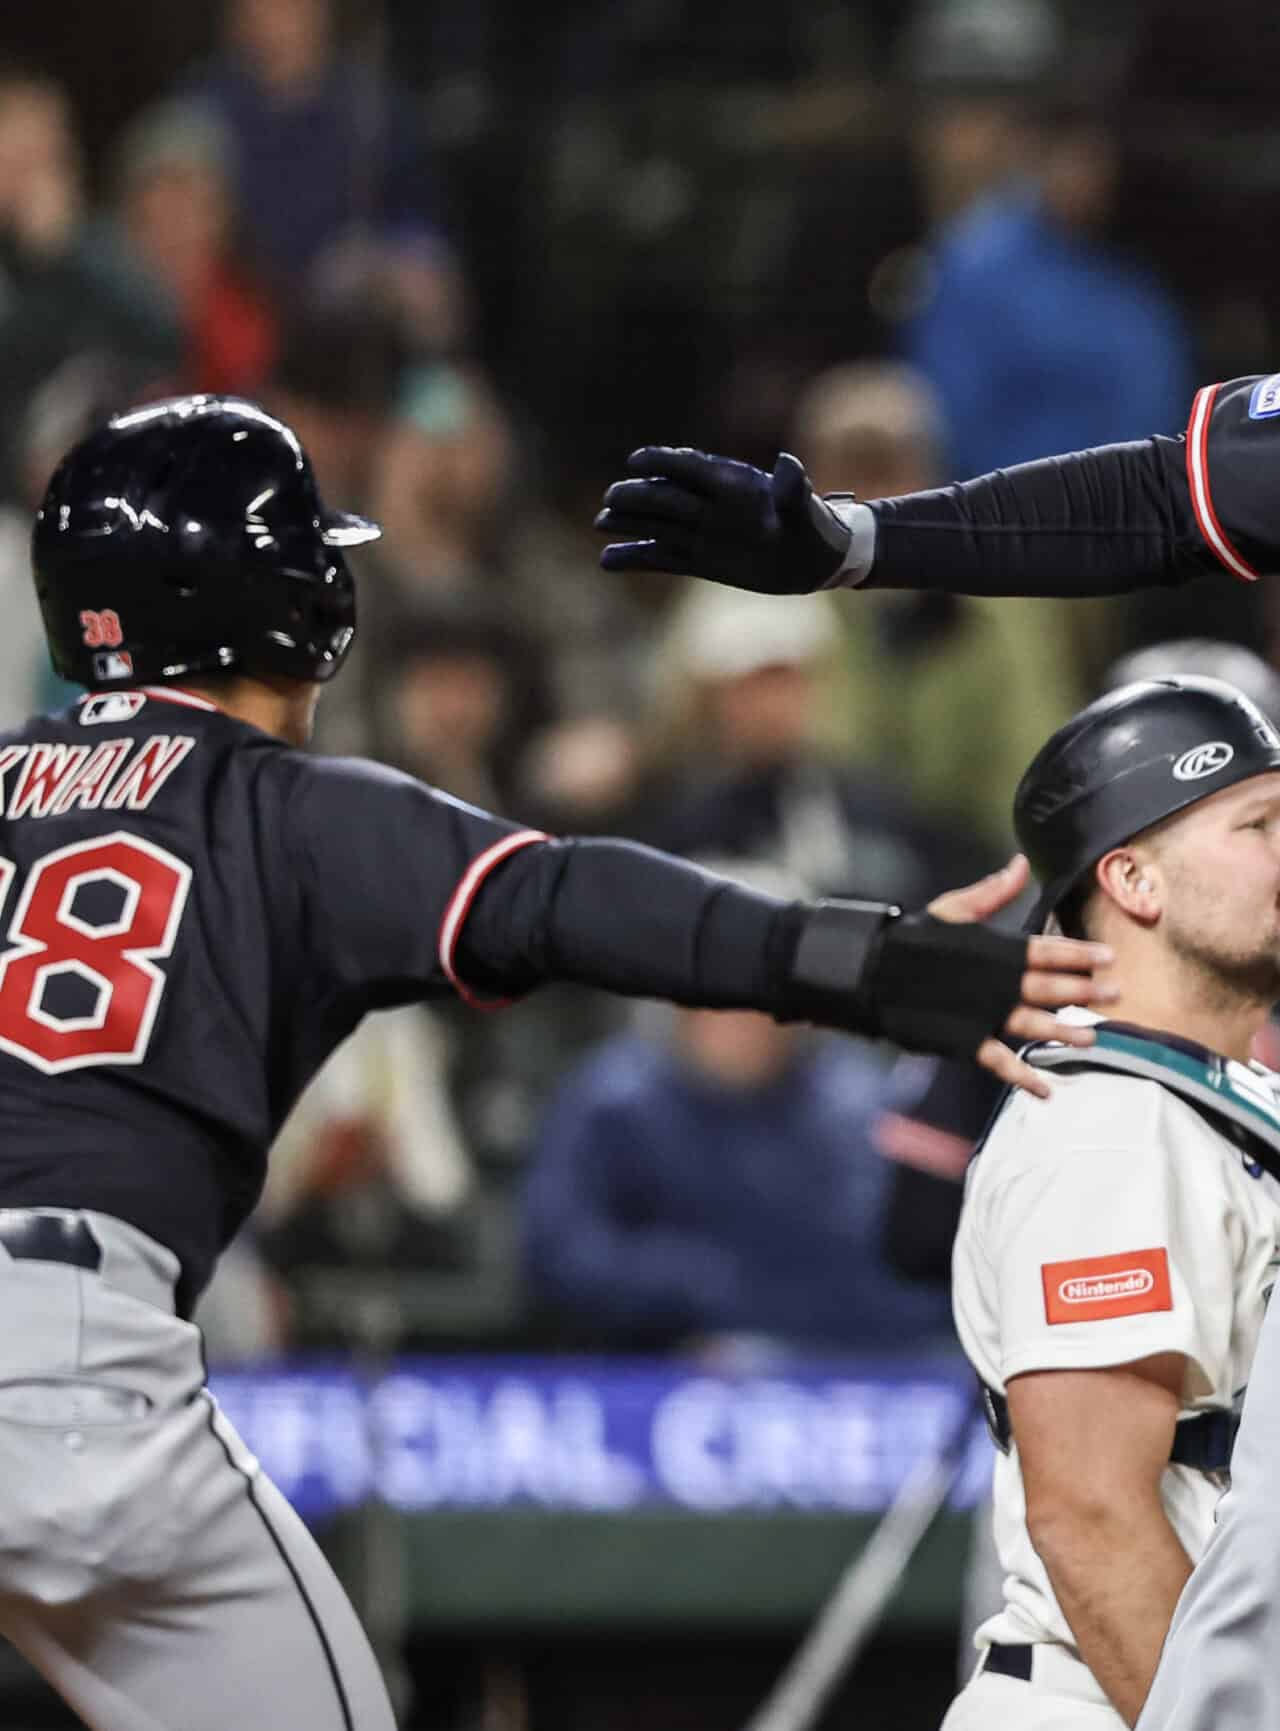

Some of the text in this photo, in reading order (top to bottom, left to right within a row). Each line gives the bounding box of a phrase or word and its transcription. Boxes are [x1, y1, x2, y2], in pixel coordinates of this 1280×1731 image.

[80, 609, 123, 647] 38
[0, 830, 193, 1075] 8
[1067, 1273, 1145, 1298] Nintendo
